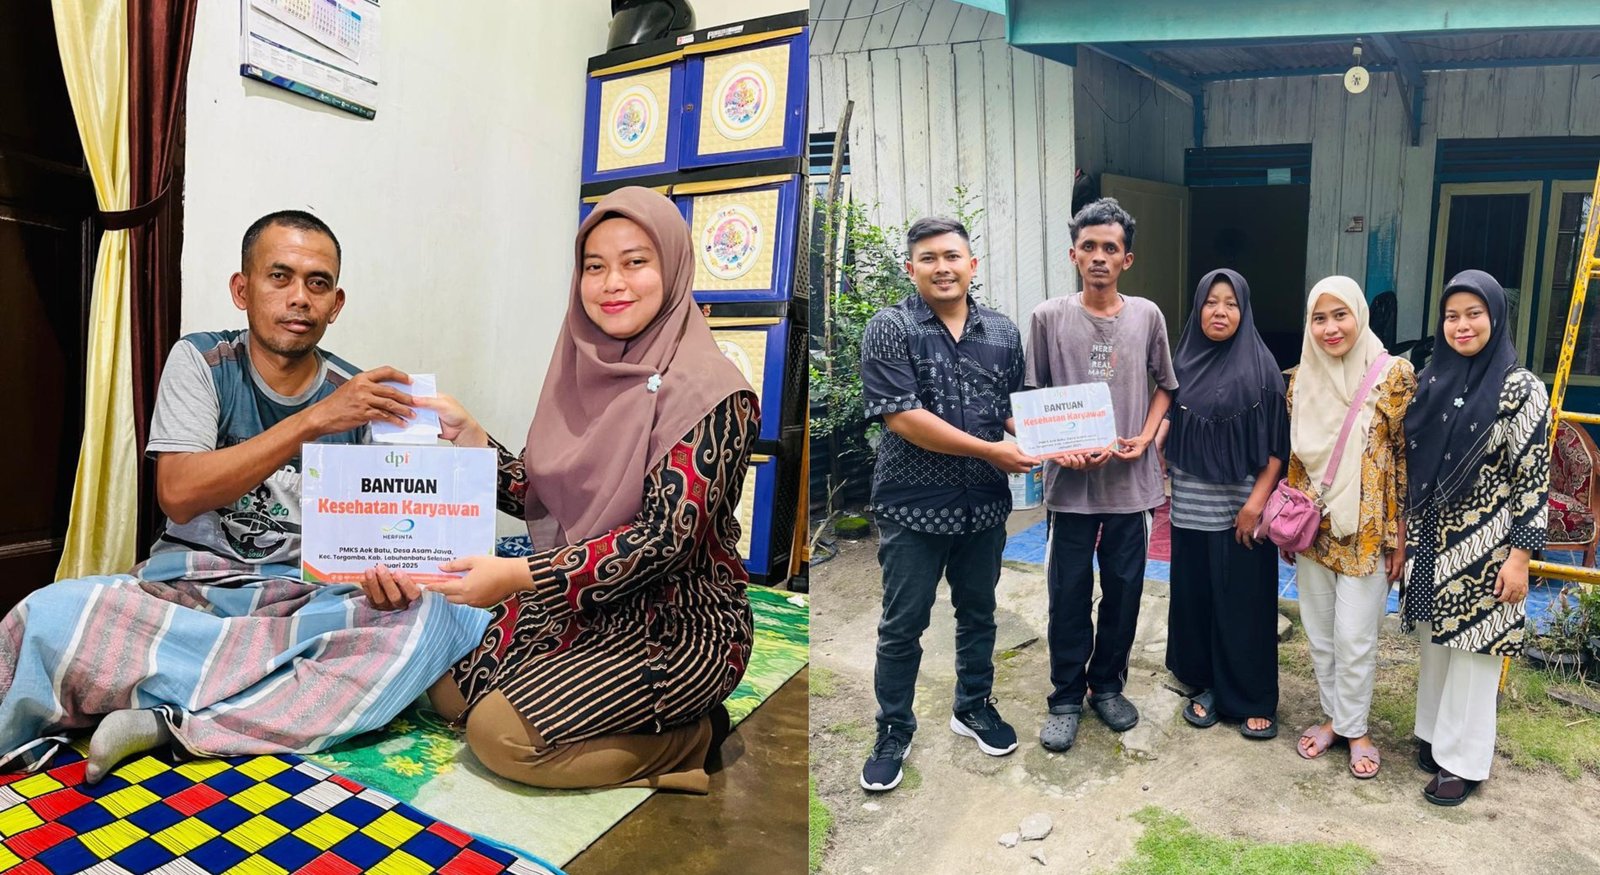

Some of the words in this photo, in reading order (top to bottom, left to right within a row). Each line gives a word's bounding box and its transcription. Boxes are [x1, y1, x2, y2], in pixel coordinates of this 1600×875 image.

[1092, 344, 1113, 353] HERE
[1092, 360, 1112, 369] REAL
[1088, 369, 1115, 377] MAGIC
[1044, 401, 1084, 412] BANTUAN
[1023, 415, 1066, 427] Kesehatan
[1067, 410, 1106, 420] Karyawan
[385, 451, 410, 467] dpi
[361, 478, 437, 494] BANTUAN
[318, 499, 398, 514] Kesehatan
[402, 500, 480, 517] Karyawan
